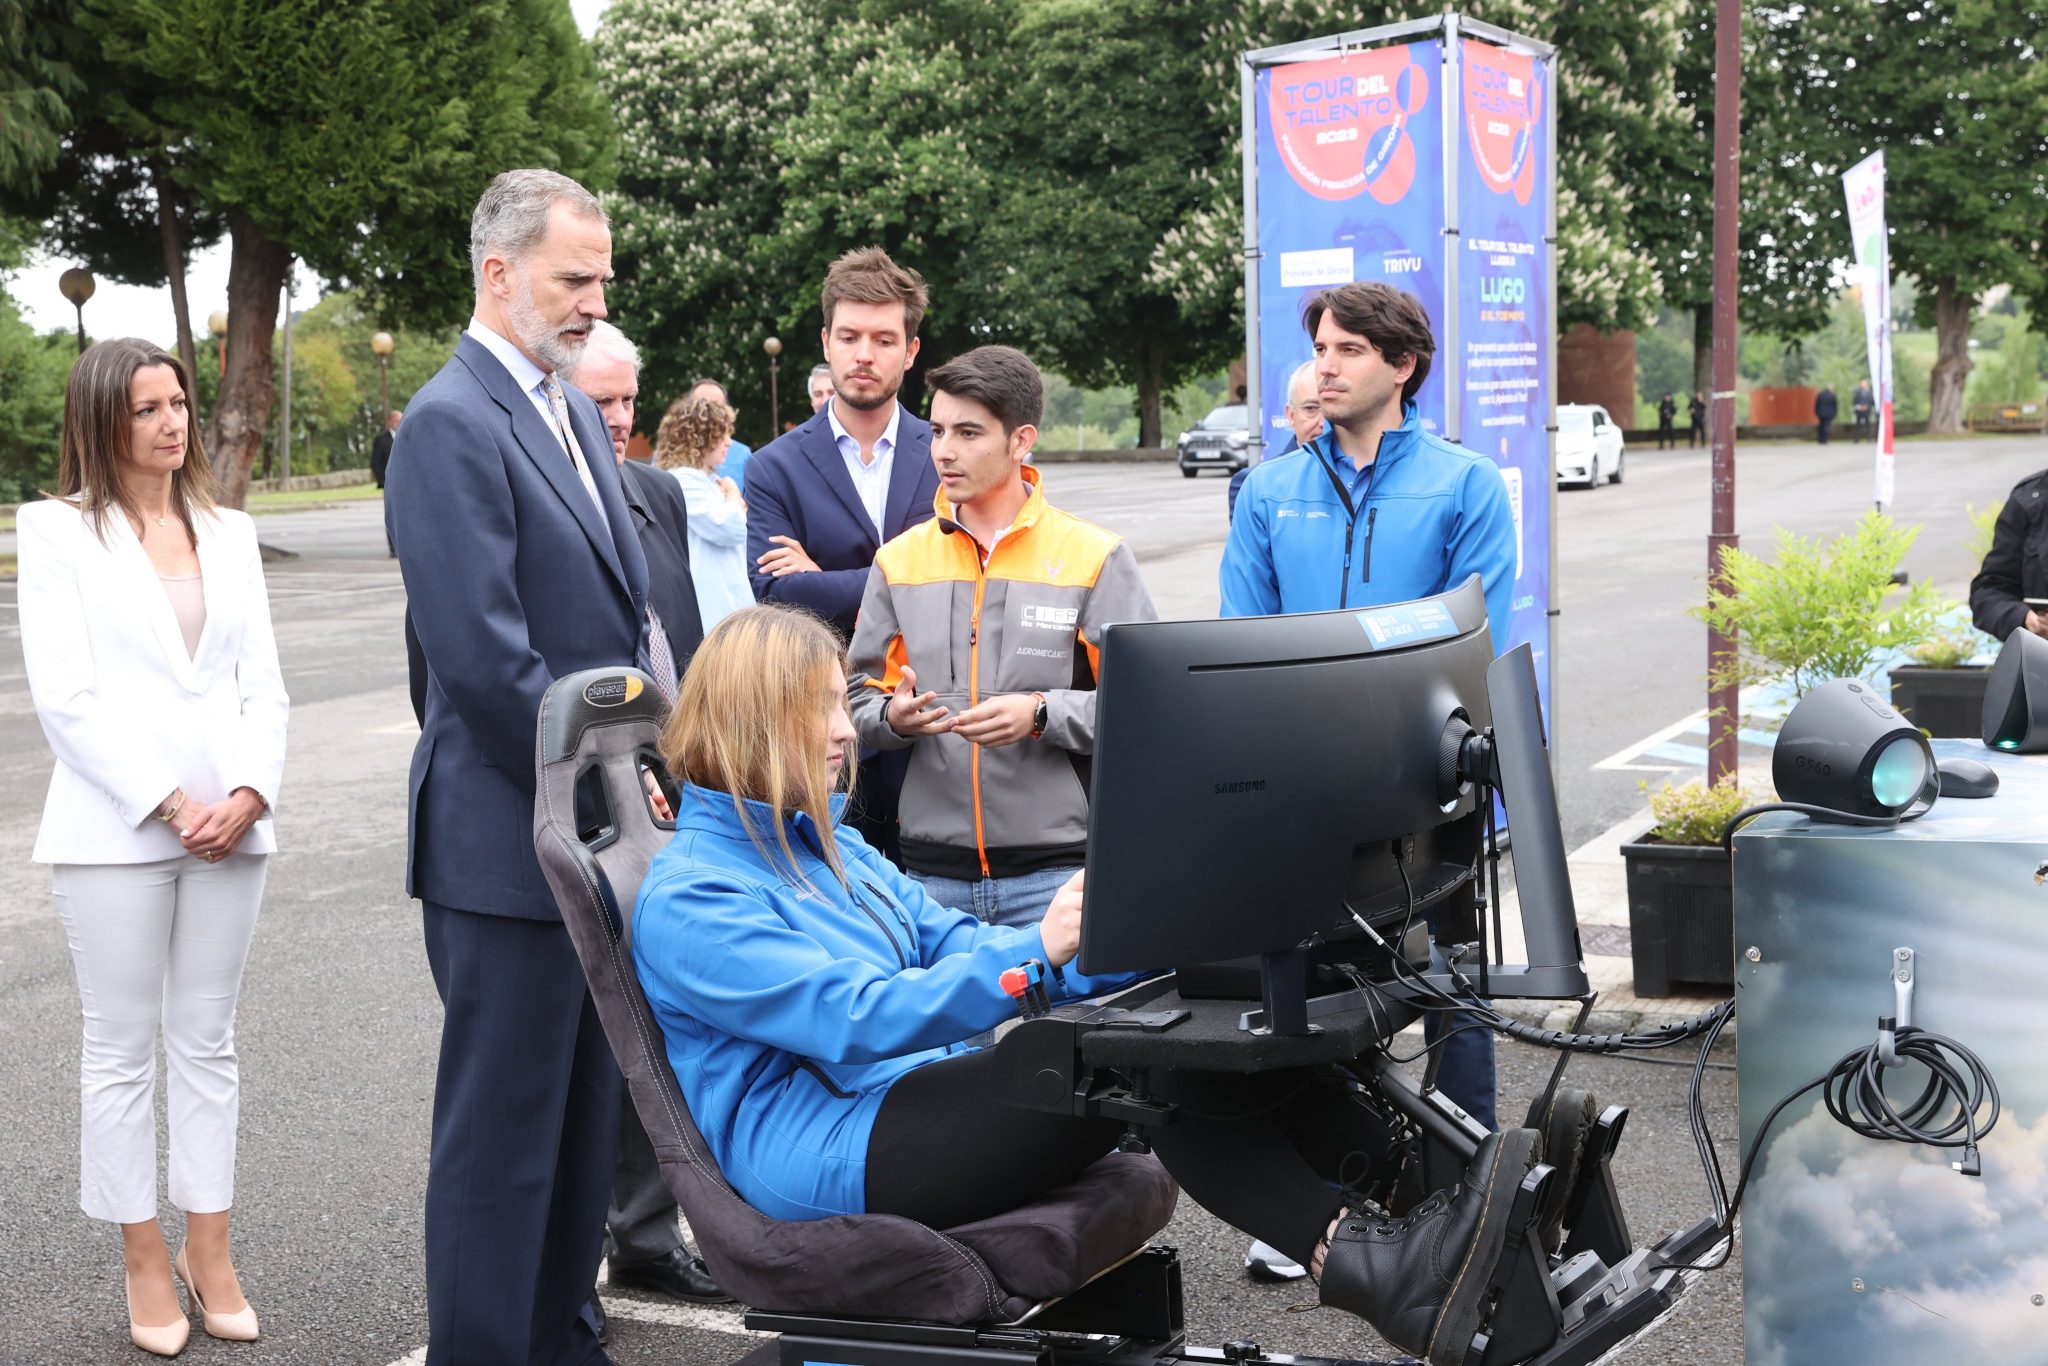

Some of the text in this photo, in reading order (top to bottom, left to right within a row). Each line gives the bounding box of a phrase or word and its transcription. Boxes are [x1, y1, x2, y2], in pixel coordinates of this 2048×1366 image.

[1472, 64, 1507, 90] TOUR
[1284, 75, 1389, 106] TOUR DEL
[1285, 97, 1392, 129] TALENTO
[1472, 91, 1525, 118] TALENTO
[1316, 127, 1358, 145] 2023
[1365, 159, 1379, 176] DE
[1377, 113, 1402, 162] GIRONA
[1284, 265, 1350, 278] Princesa de Girona
[1383, 257, 1421, 274] TRIVU
[1480, 276, 1525, 304] LUGO
[1022, 605, 1078, 623] CIFP
[588, 683, 626, 698] playseat
[1795, 755, 1831, 776] G560
[1214, 780, 1266, 794] SAMSUNG
